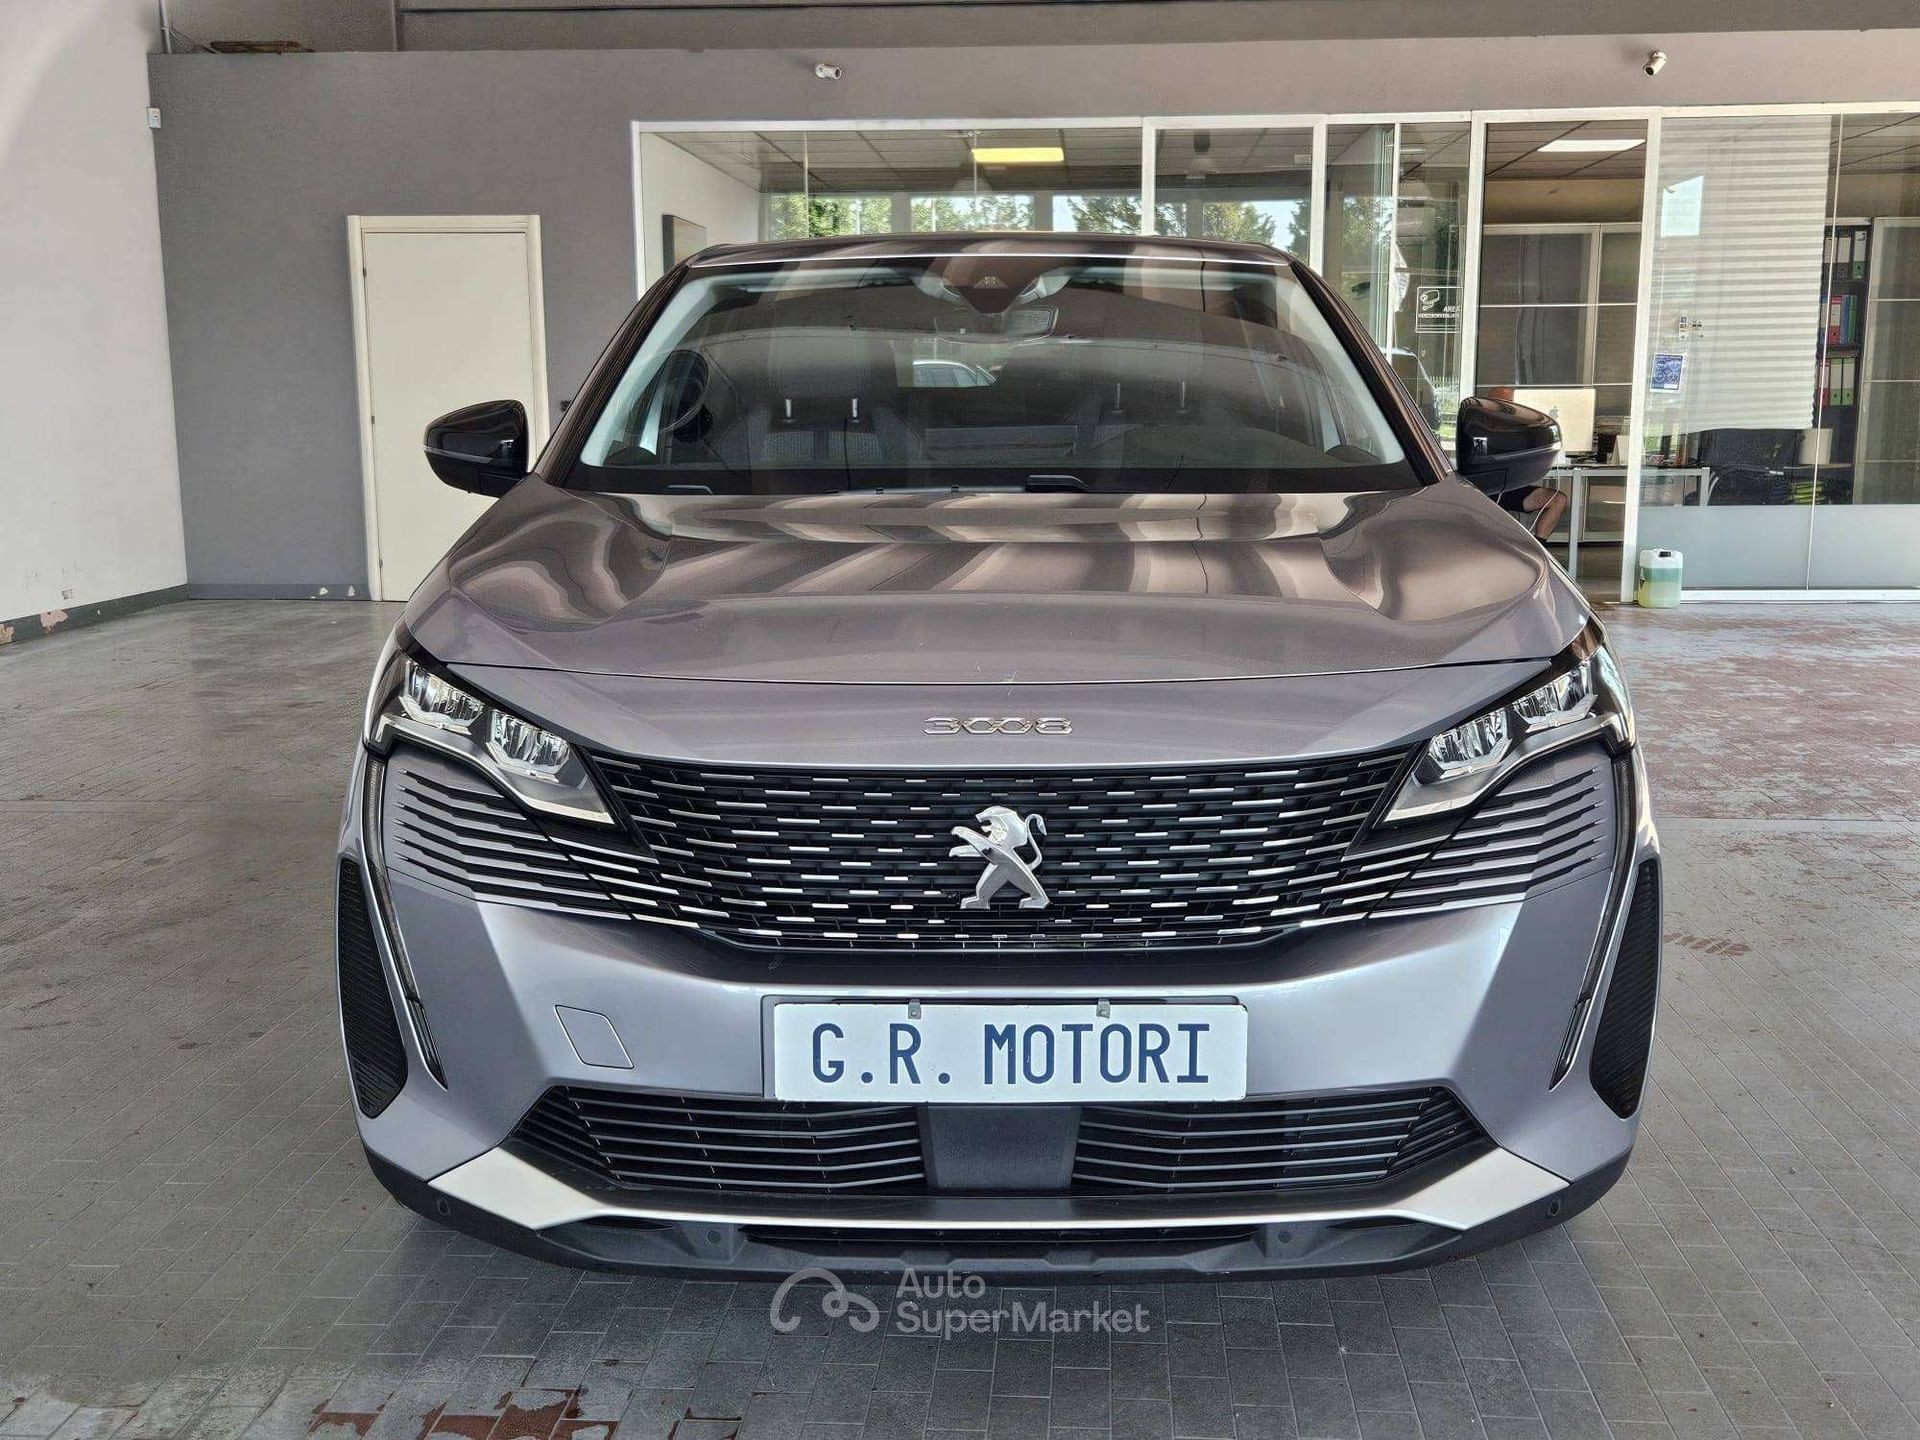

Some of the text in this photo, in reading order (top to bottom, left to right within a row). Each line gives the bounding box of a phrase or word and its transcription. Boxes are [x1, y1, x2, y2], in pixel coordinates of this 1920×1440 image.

[923, 717, 1073, 735] 3008
[812, 1023, 1210, 1085] G.R. MOTORI
